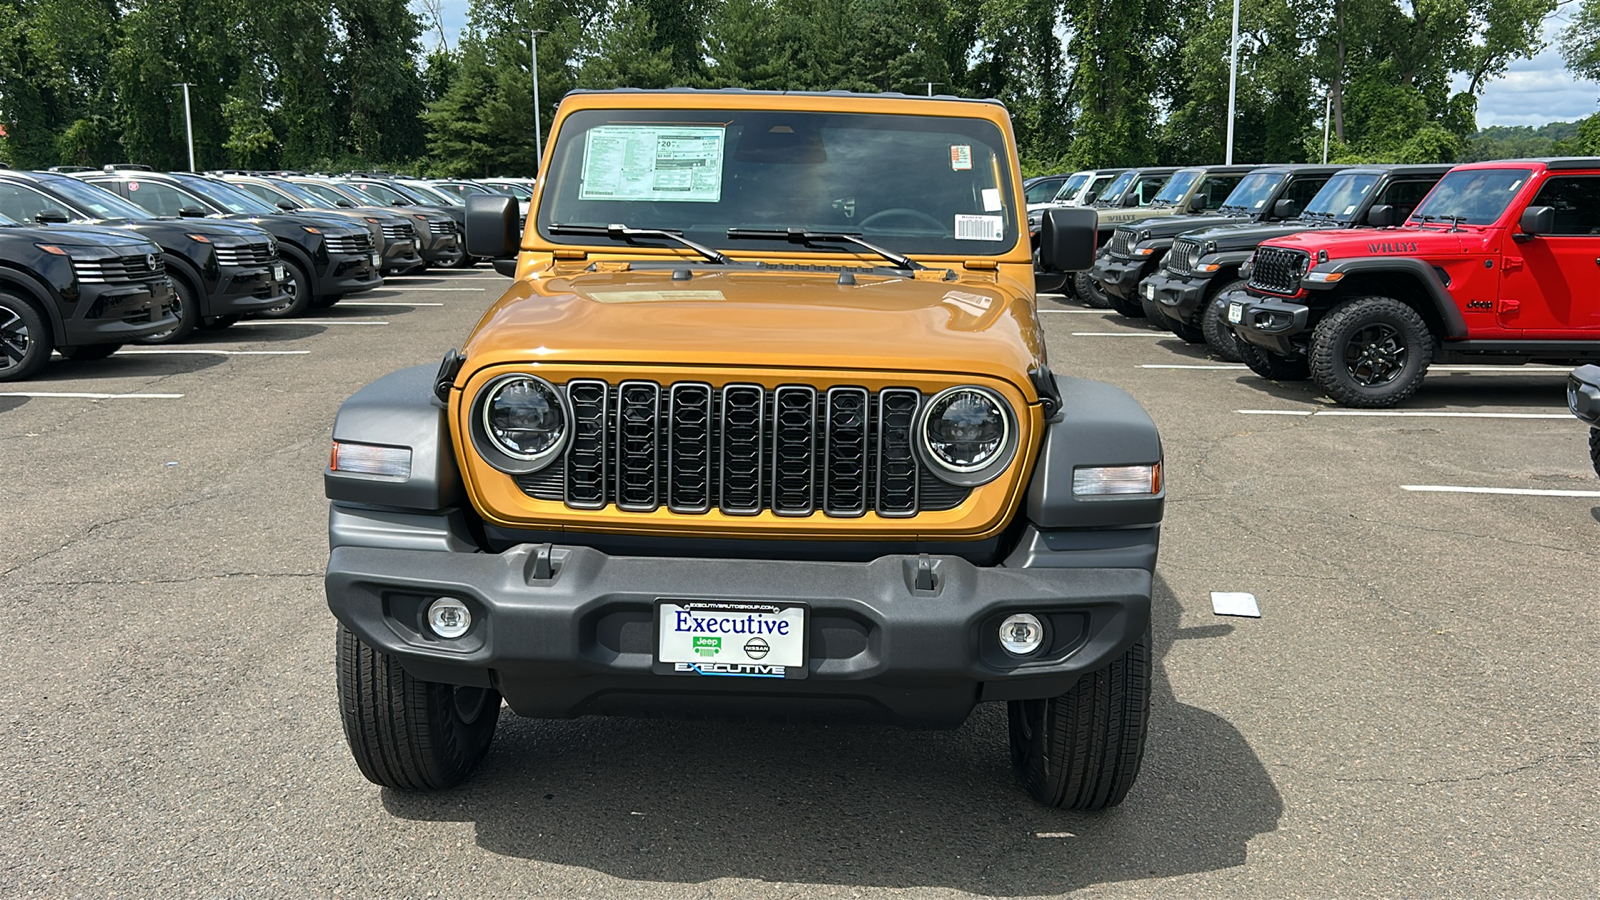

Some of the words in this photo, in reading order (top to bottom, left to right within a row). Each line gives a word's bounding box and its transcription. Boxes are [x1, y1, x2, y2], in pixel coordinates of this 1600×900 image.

[661, 140, 671, 148] 20
[1367, 242, 1418, 253] WILLYS
[1466, 299, 1493, 309] Jeep
[689, 602, 774, 610] EXECUTIVEAUTOGROUP.COM
[674, 610, 789, 635] Executive
[696, 637, 718, 646] Jeep
[674, 662, 786, 675] EXECUTIVE
